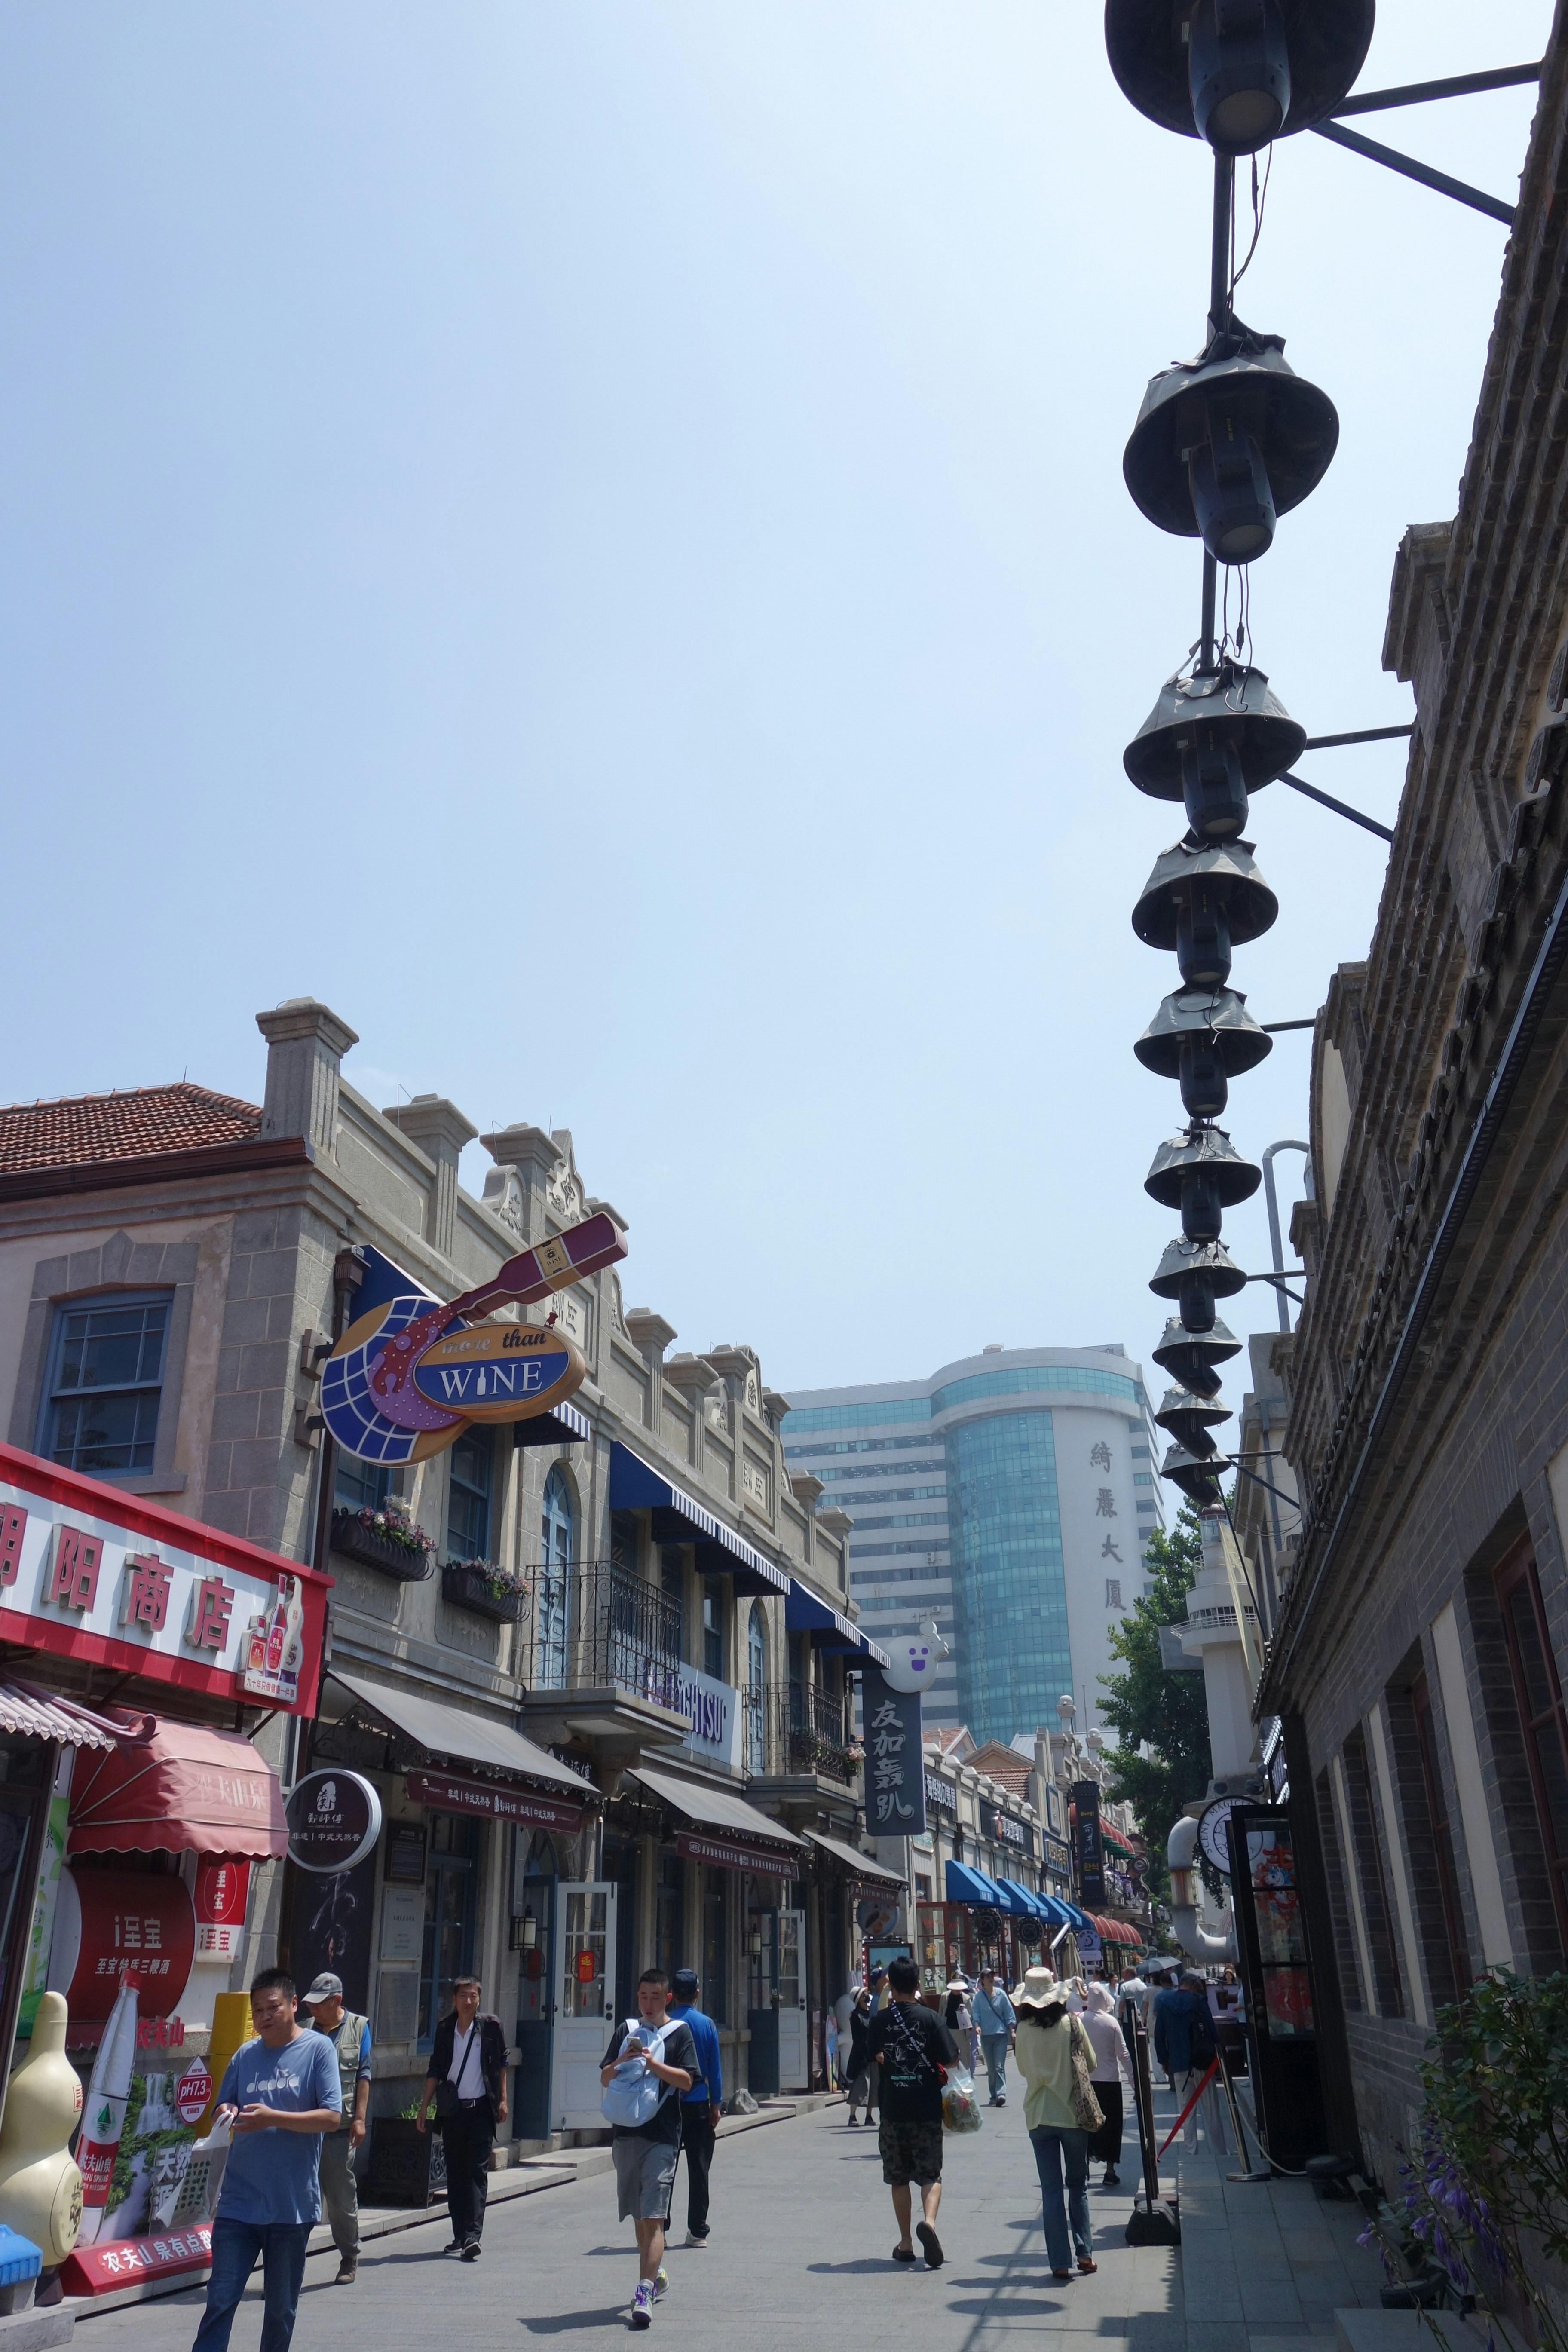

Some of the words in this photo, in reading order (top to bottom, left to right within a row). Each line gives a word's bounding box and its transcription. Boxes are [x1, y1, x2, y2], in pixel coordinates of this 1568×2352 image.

[442, 1338, 491, 1354] more
[502, 1329, 546, 1348] than
[438, 1362, 542, 1399] WINE
[246, 1677, 294, 1698] 九十年只做健康一件事
[871, 1700, 914, 1822] 友加轰趴
[1202, 1821, 1213, 1855] SCENT
[214, 1870, 226, 1910] 至宝
[80, 2154, 112, 2173] 农夫山泉
[93, 2174, 109, 2183] SPRING
